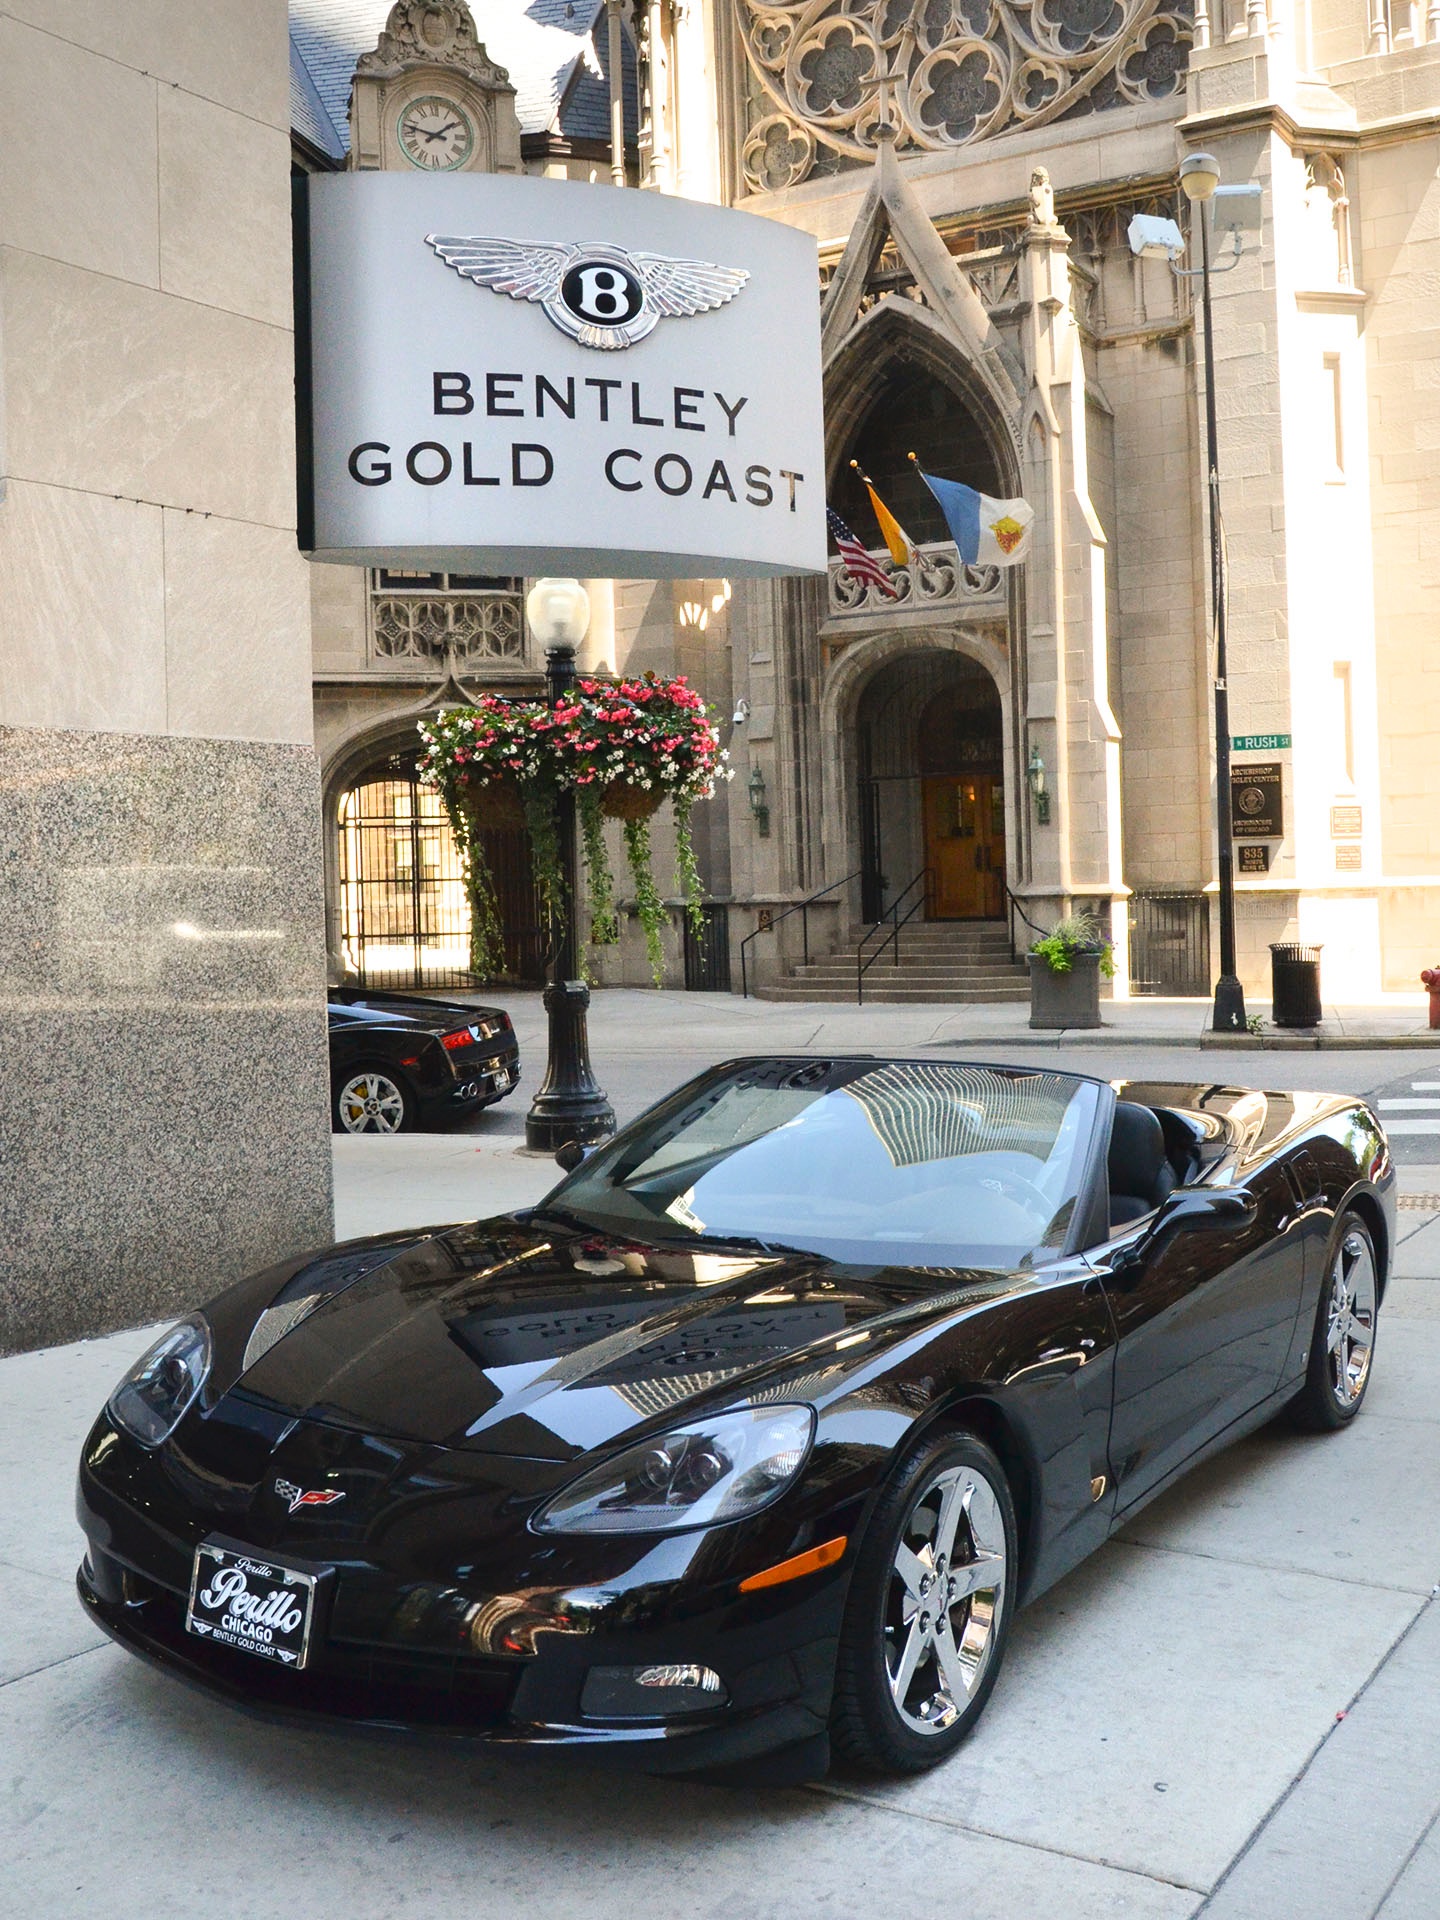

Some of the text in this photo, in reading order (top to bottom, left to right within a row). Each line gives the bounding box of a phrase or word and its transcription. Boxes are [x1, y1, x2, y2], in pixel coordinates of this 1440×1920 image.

[578, 267, 630, 319] B
[433, 371, 748, 436] BENTLEY
[348, 441, 804, 512] GOLD COAST
[1245, 736, 1278, 749] RUSH
[1281, 737, 1289, 746] ST
[1253, 775, 1279, 783] CENTER
[1243, 847, 1264, 859] 835
[234, 1558, 273, 1577] Perillo
[200, 1568, 302, 1633] Perillo
[212, 1628, 276, 1657] BENTLEY GOLD COAST
[221, 1614, 273, 1643] CHICAGO
